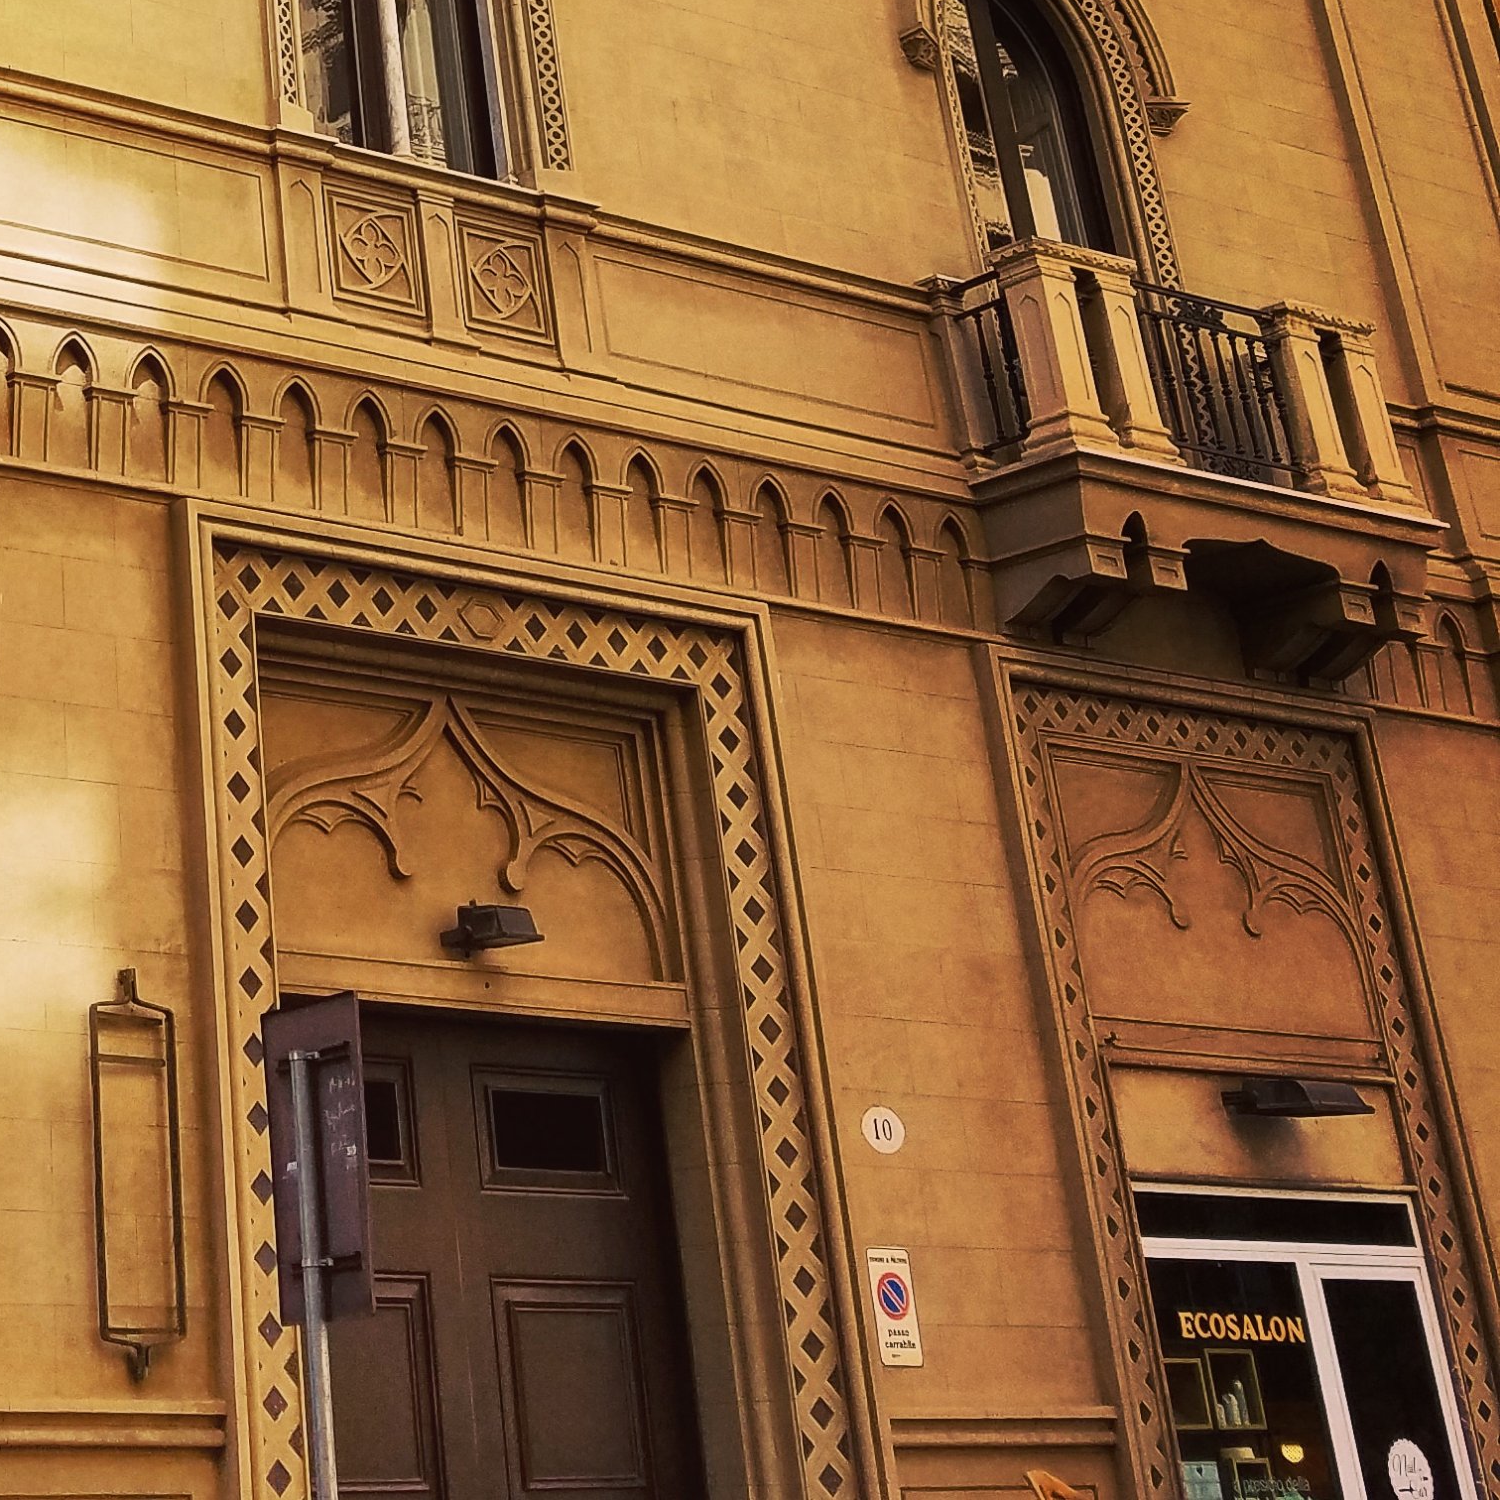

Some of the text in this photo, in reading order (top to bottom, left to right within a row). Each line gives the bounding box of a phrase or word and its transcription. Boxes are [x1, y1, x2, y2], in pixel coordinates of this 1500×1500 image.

[873, 1118, 892, 1141] 10
[1178, 1311, 1306, 1343] ECOSALON
[885, 1340, 916, 1348] carrabile
